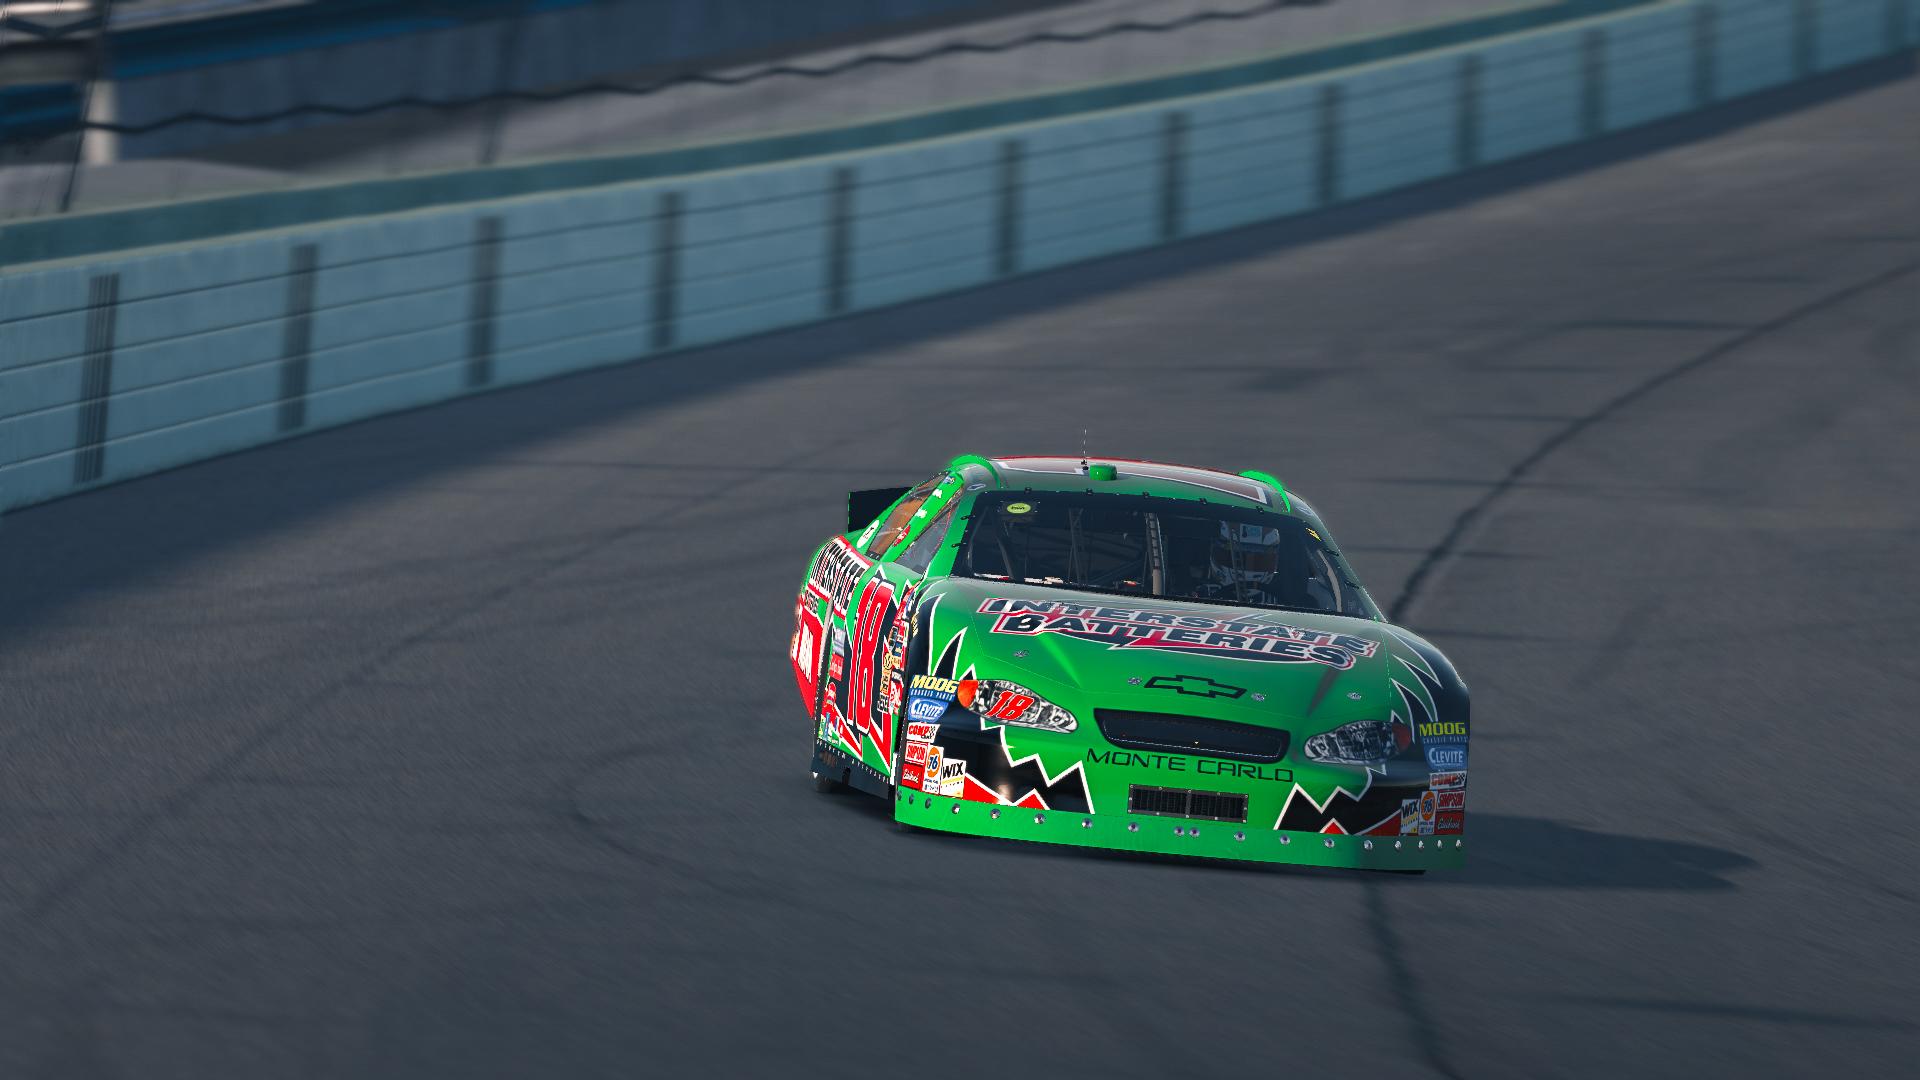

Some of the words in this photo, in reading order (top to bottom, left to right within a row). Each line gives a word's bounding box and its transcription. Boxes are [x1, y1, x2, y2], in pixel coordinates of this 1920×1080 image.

[978, 598, 1378, 657] INTERSTATE
[993, 612, 1356, 669] BATTERIES
[847, 577, 895, 734] 18
[910, 675, 959, 693] MOOG
[911, 699, 943, 717] CLEVITE
[985, 690, 1034, 720] 18
[1419, 722, 1465, 736] MOOG
[928, 755, 938, 769] 76
[1428, 748, 1464, 763] CLEVITE
[943, 762, 963, 779] WIX
[1087, 748, 1186, 771] MONTE
[1197, 759, 1294, 783] CARLO
[1401, 801, 1418, 818] WIX
